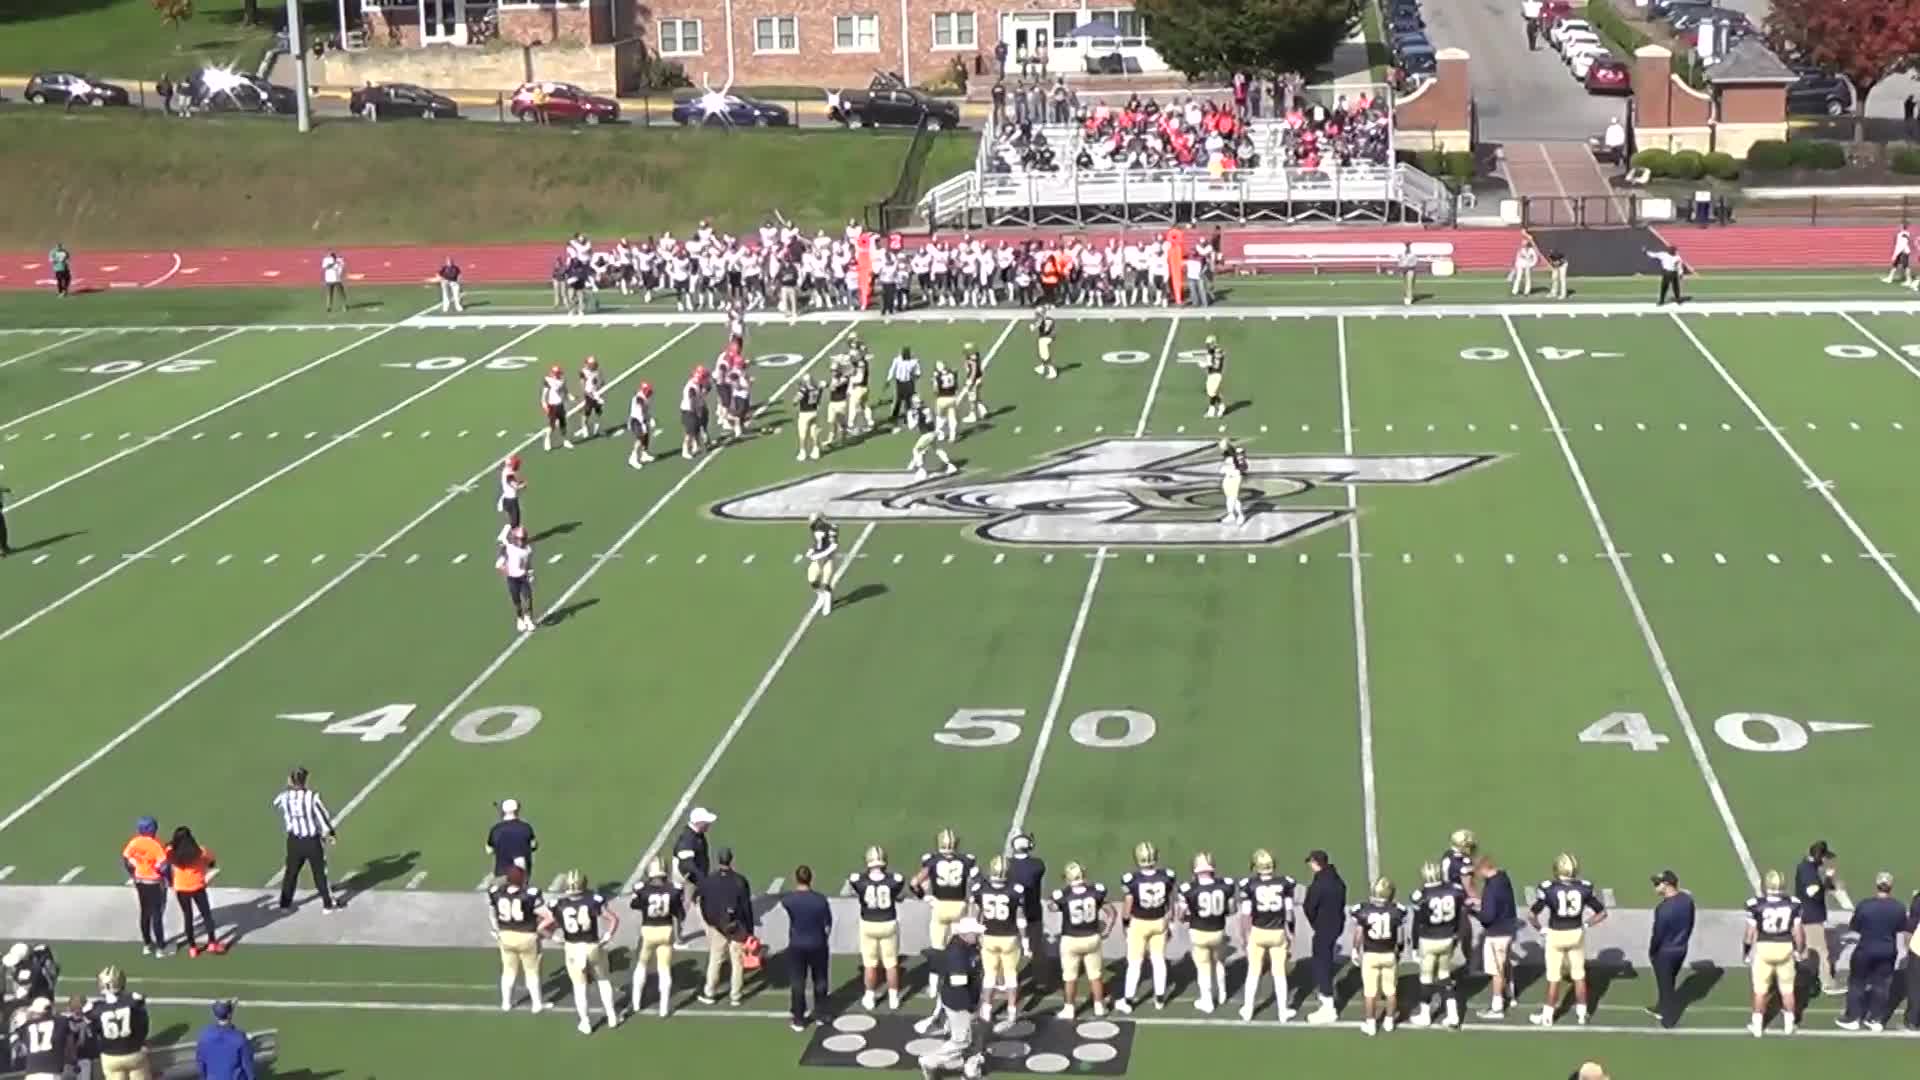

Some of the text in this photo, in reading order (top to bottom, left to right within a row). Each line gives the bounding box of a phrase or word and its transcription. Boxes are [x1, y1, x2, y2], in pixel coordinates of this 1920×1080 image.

[890, 234, 902, 249] 2
[497, 896, 524, 922] 94
[648, 893, 672, 918] 21
[981, 893, 1010, 921] 56
[1198, 889, 1225, 918] 90
[1255, 884, 1285, 913] 95
[1429, 895, 1456, 925] 39
[1556, 889, 1583, 918] 13
[562, 904, 591, 934] 64
[1367, 911, 1392, 941] 31
[28, 1019, 55, 1053] 17
[100, 1007, 131, 1040] 67
